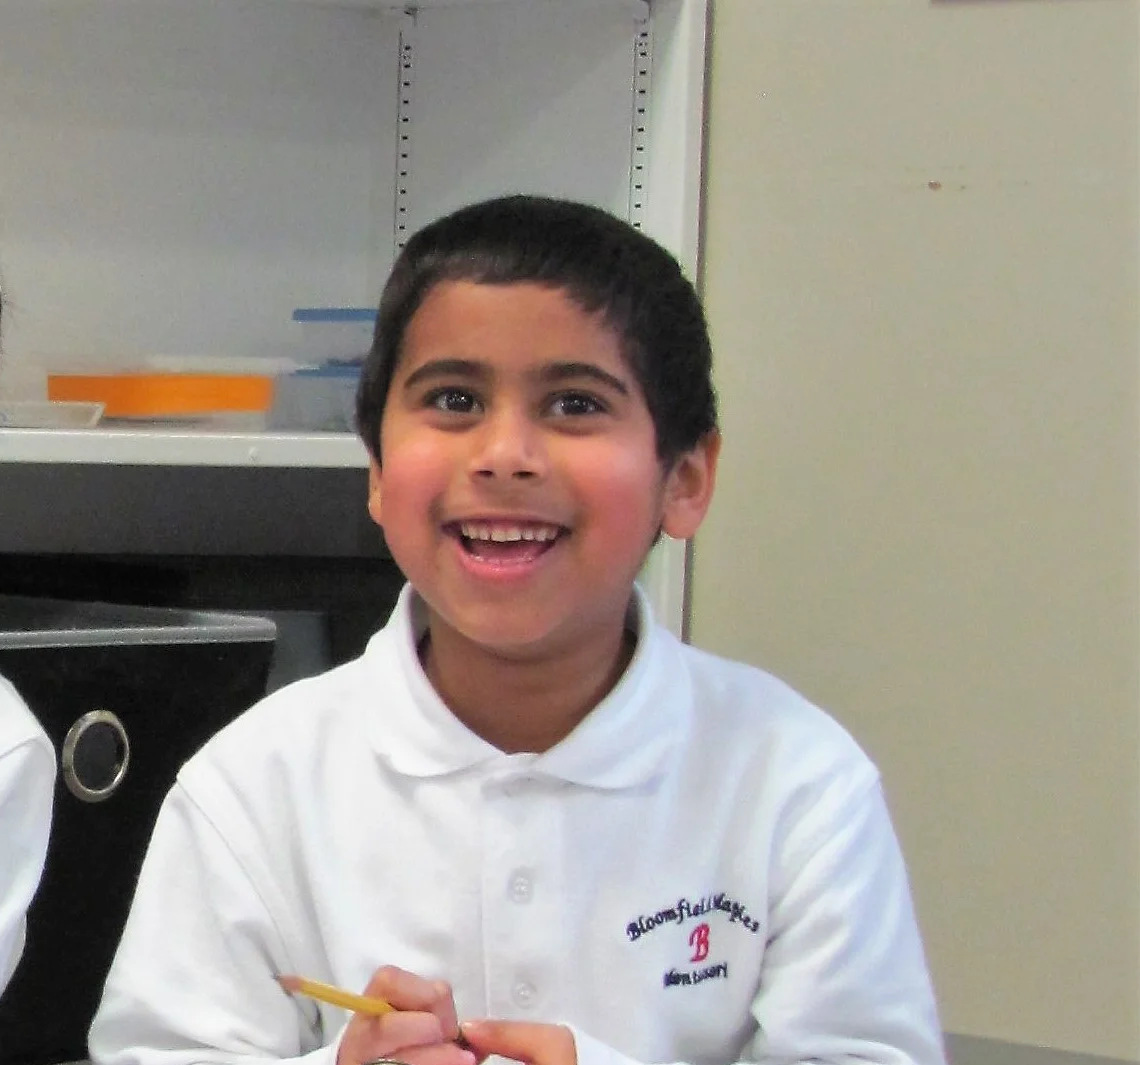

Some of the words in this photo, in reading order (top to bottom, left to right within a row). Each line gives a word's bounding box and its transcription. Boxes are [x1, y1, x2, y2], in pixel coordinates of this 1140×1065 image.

[626, 898, 711, 941] Bloomfield
[688, 922, 711, 963] B
[663, 961, 728, 988] Montessori
